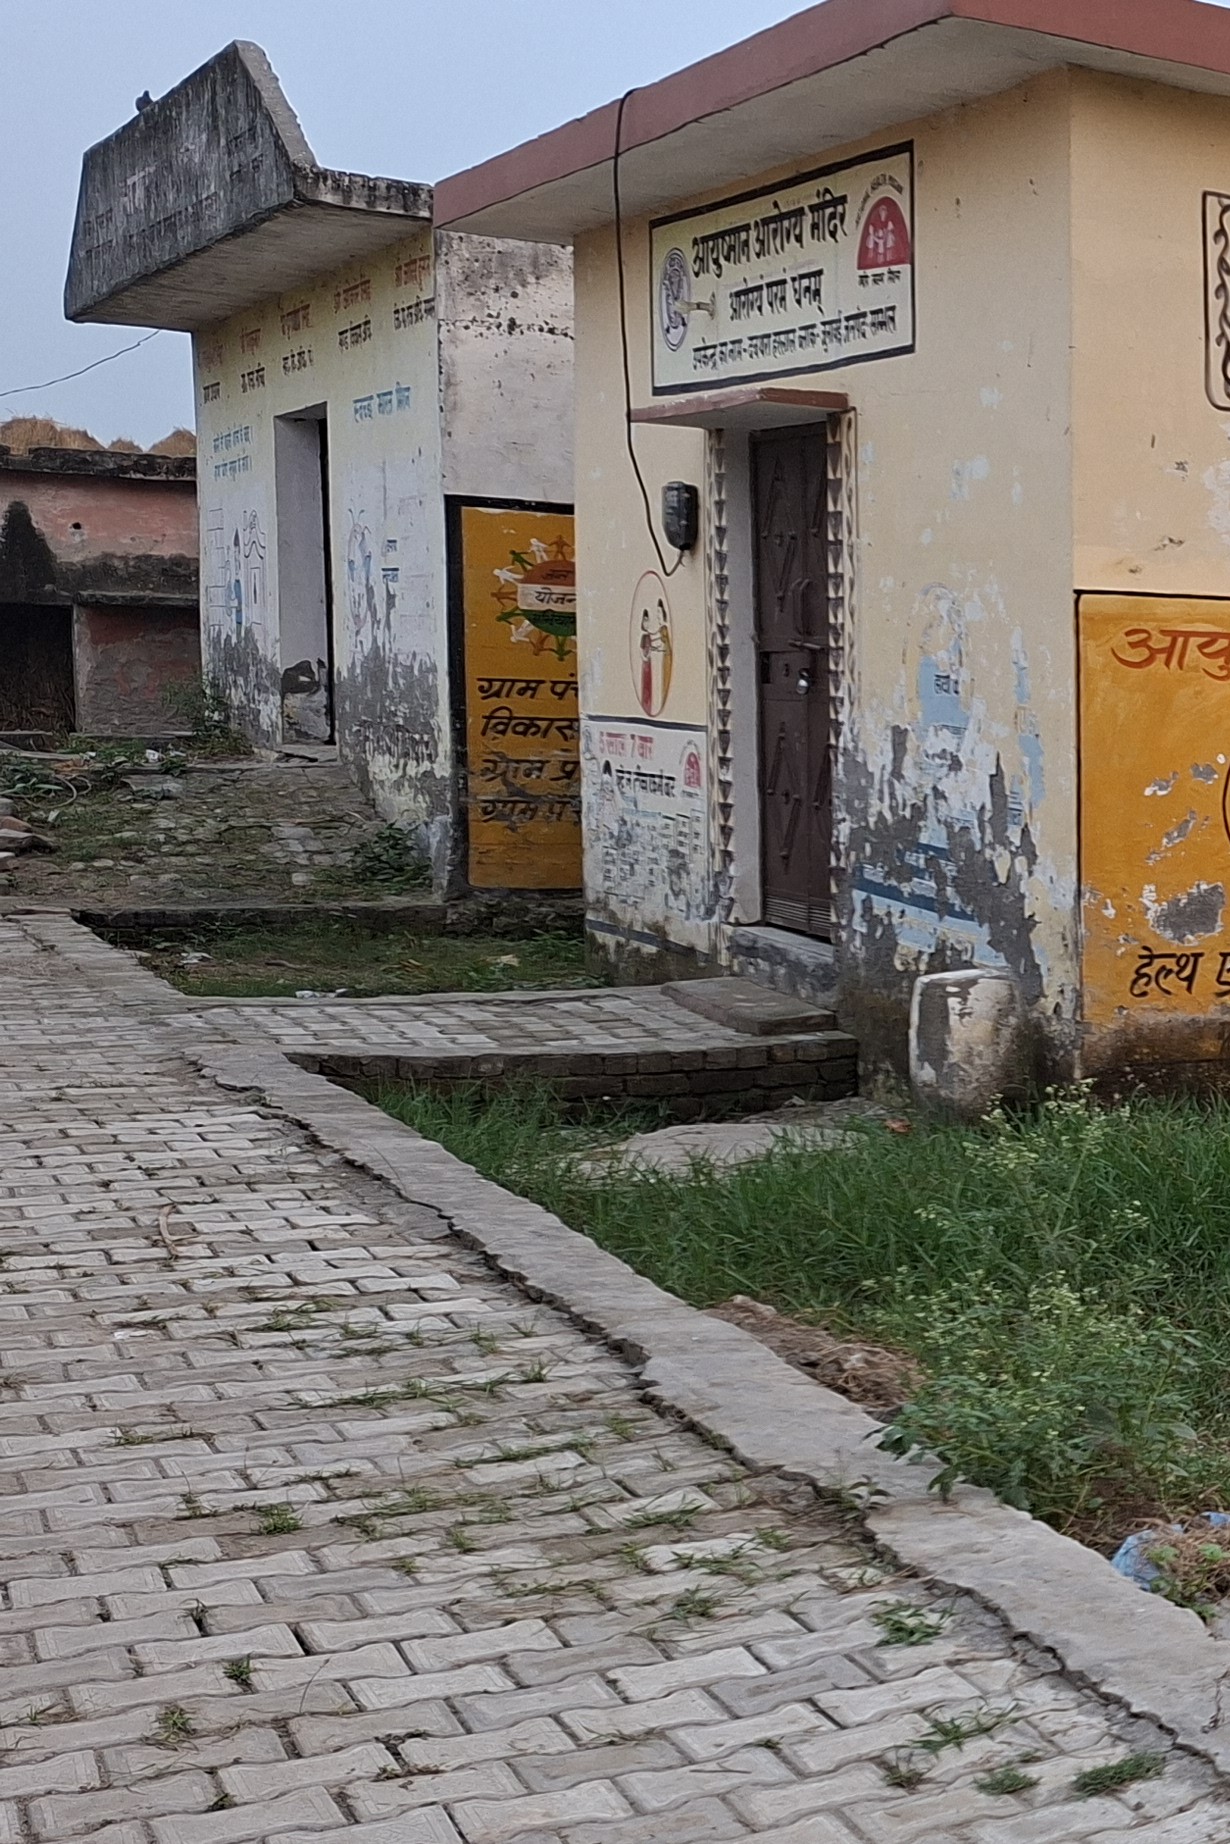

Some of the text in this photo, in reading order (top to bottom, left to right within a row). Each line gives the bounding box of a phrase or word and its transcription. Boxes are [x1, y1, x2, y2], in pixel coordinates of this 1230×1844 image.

[691, 222, 752, 280] आयुष्मान
[752, 200, 806, 260] आरोग्य
[807, 187, 849, 244] मंदिर
[476, 677, 546, 701] ग्राम
[1130, 945, 1203, 997] हेल्थ
